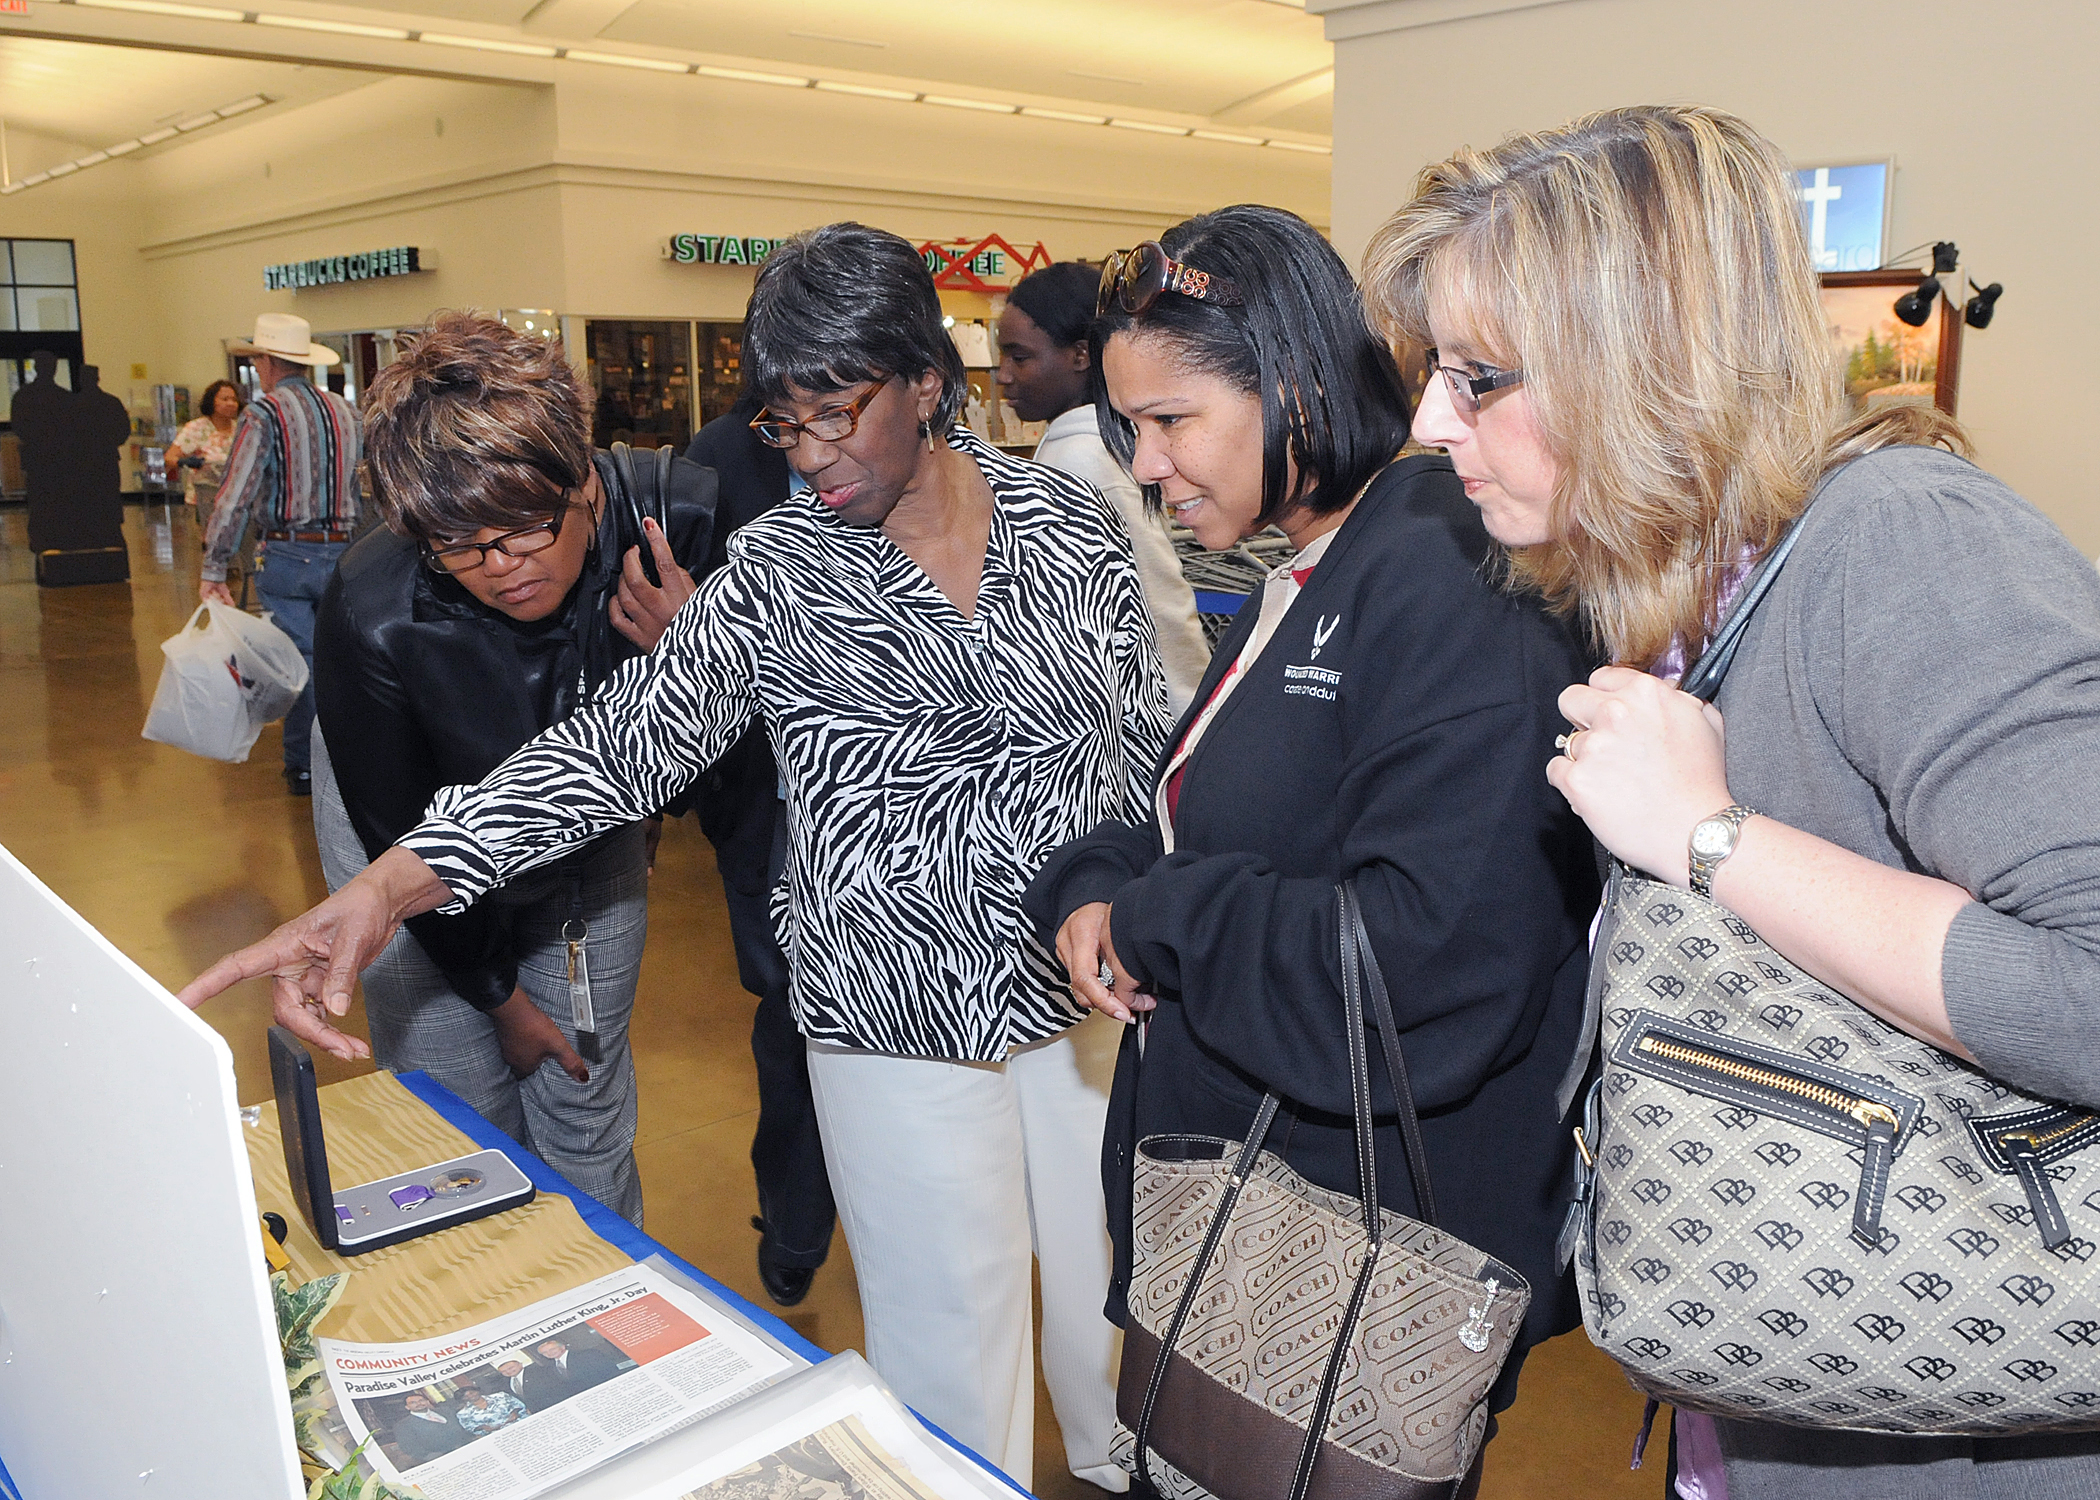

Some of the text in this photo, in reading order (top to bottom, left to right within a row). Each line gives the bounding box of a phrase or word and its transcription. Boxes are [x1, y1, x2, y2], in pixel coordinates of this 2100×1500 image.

[675, 232, 784, 266] STAR
[264, 246, 409, 291] STARBUCKS COFFEE
[1643, 903, 1685, 928] DB
[1719, 917, 1758, 945] DB
[1612, 941, 1645, 966] DB
[1676, 936, 1720, 962] DB
[1644, 974, 1686, 1000] DB
[1713, 970, 1758, 998] DB
[1754, 961, 1793, 985] DB
[1759, 1003, 1804, 1031] DB
[1802, 1035, 1850, 1063] DB
[1606, 1072, 1638, 1097] DB
[1630, 1103, 1674, 1129] DB
[1711, 1106, 1759, 1132] DB
[1605, 1142, 1634, 1171] DB
[1667, 1139, 1714, 1168] DB
[1752, 1141, 1802, 1169] DB
[1938, 1155, 1984, 1186] DB
[1630, 1178, 1672, 1207] DB
[1709, 1178, 1757, 1208] DB
[1796, 1181, 1850, 1213] DB
[1892, 1184, 1947, 1215] DB
[1142, 1187, 1208, 1245] COACH
[1601, 1219, 1632, 1247] DB
[1666, 1217, 1713, 1247] DB
[1751, 1220, 1804, 1253] DB
[1942, 1227, 2000, 1260] DB
[1253, 1233, 1318, 1289] COACH
[1628, 1257, 1671, 1286] DB
[1707, 1260, 1758, 1294] DB
[1799, 1267, 1855, 1300] DB
[1897, 1271, 1954, 1304] DB
[1997, 1274, 2056, 1308] DB
[1258, 1272, 1330, 1327] COACH
[1372, 1300, 1460, 1352] COACH
[1664, 1299, 1715, 1330] DB
[1754, 1308, 1809, 1339] DB
[1850, 1313, 1906, 1344] DB
[344, 1381, 398, 1394] Paradise
[397, 1372, 437, 1387] Valley
[439, 1348, 500, 1376] celebrates
[499, 1331, 540, 1353] Martin
[539, 1315, 578, 1335] Luther
[609, 1297, 625, 1306] Jr.
[625, 1286, 649, 1298] Day
[1260, 1310, 1340, 1366] COACH
[1949, 1316, 2006, 1347] DB
[335, 1338, 481, 1370] COMMUNITY NEWS
[1621, 1336, 1672, 1361] DB
[1711, 1342, 1763, 1368] DB
[1669, 1368, 1719, 1386] DB
[1804, 1352, 1859, 1377] DB
[1900, 1355, 1957, 1383] DB
[2000, 1358, 2058, 1383] DB
[1761, 1376, 1812, 1394] DB
[1856, 1386, 1907, 1402] DB
[1953, 1391, 2007, 1407] DB
[1809, 1400, 1859, 1415] DB
